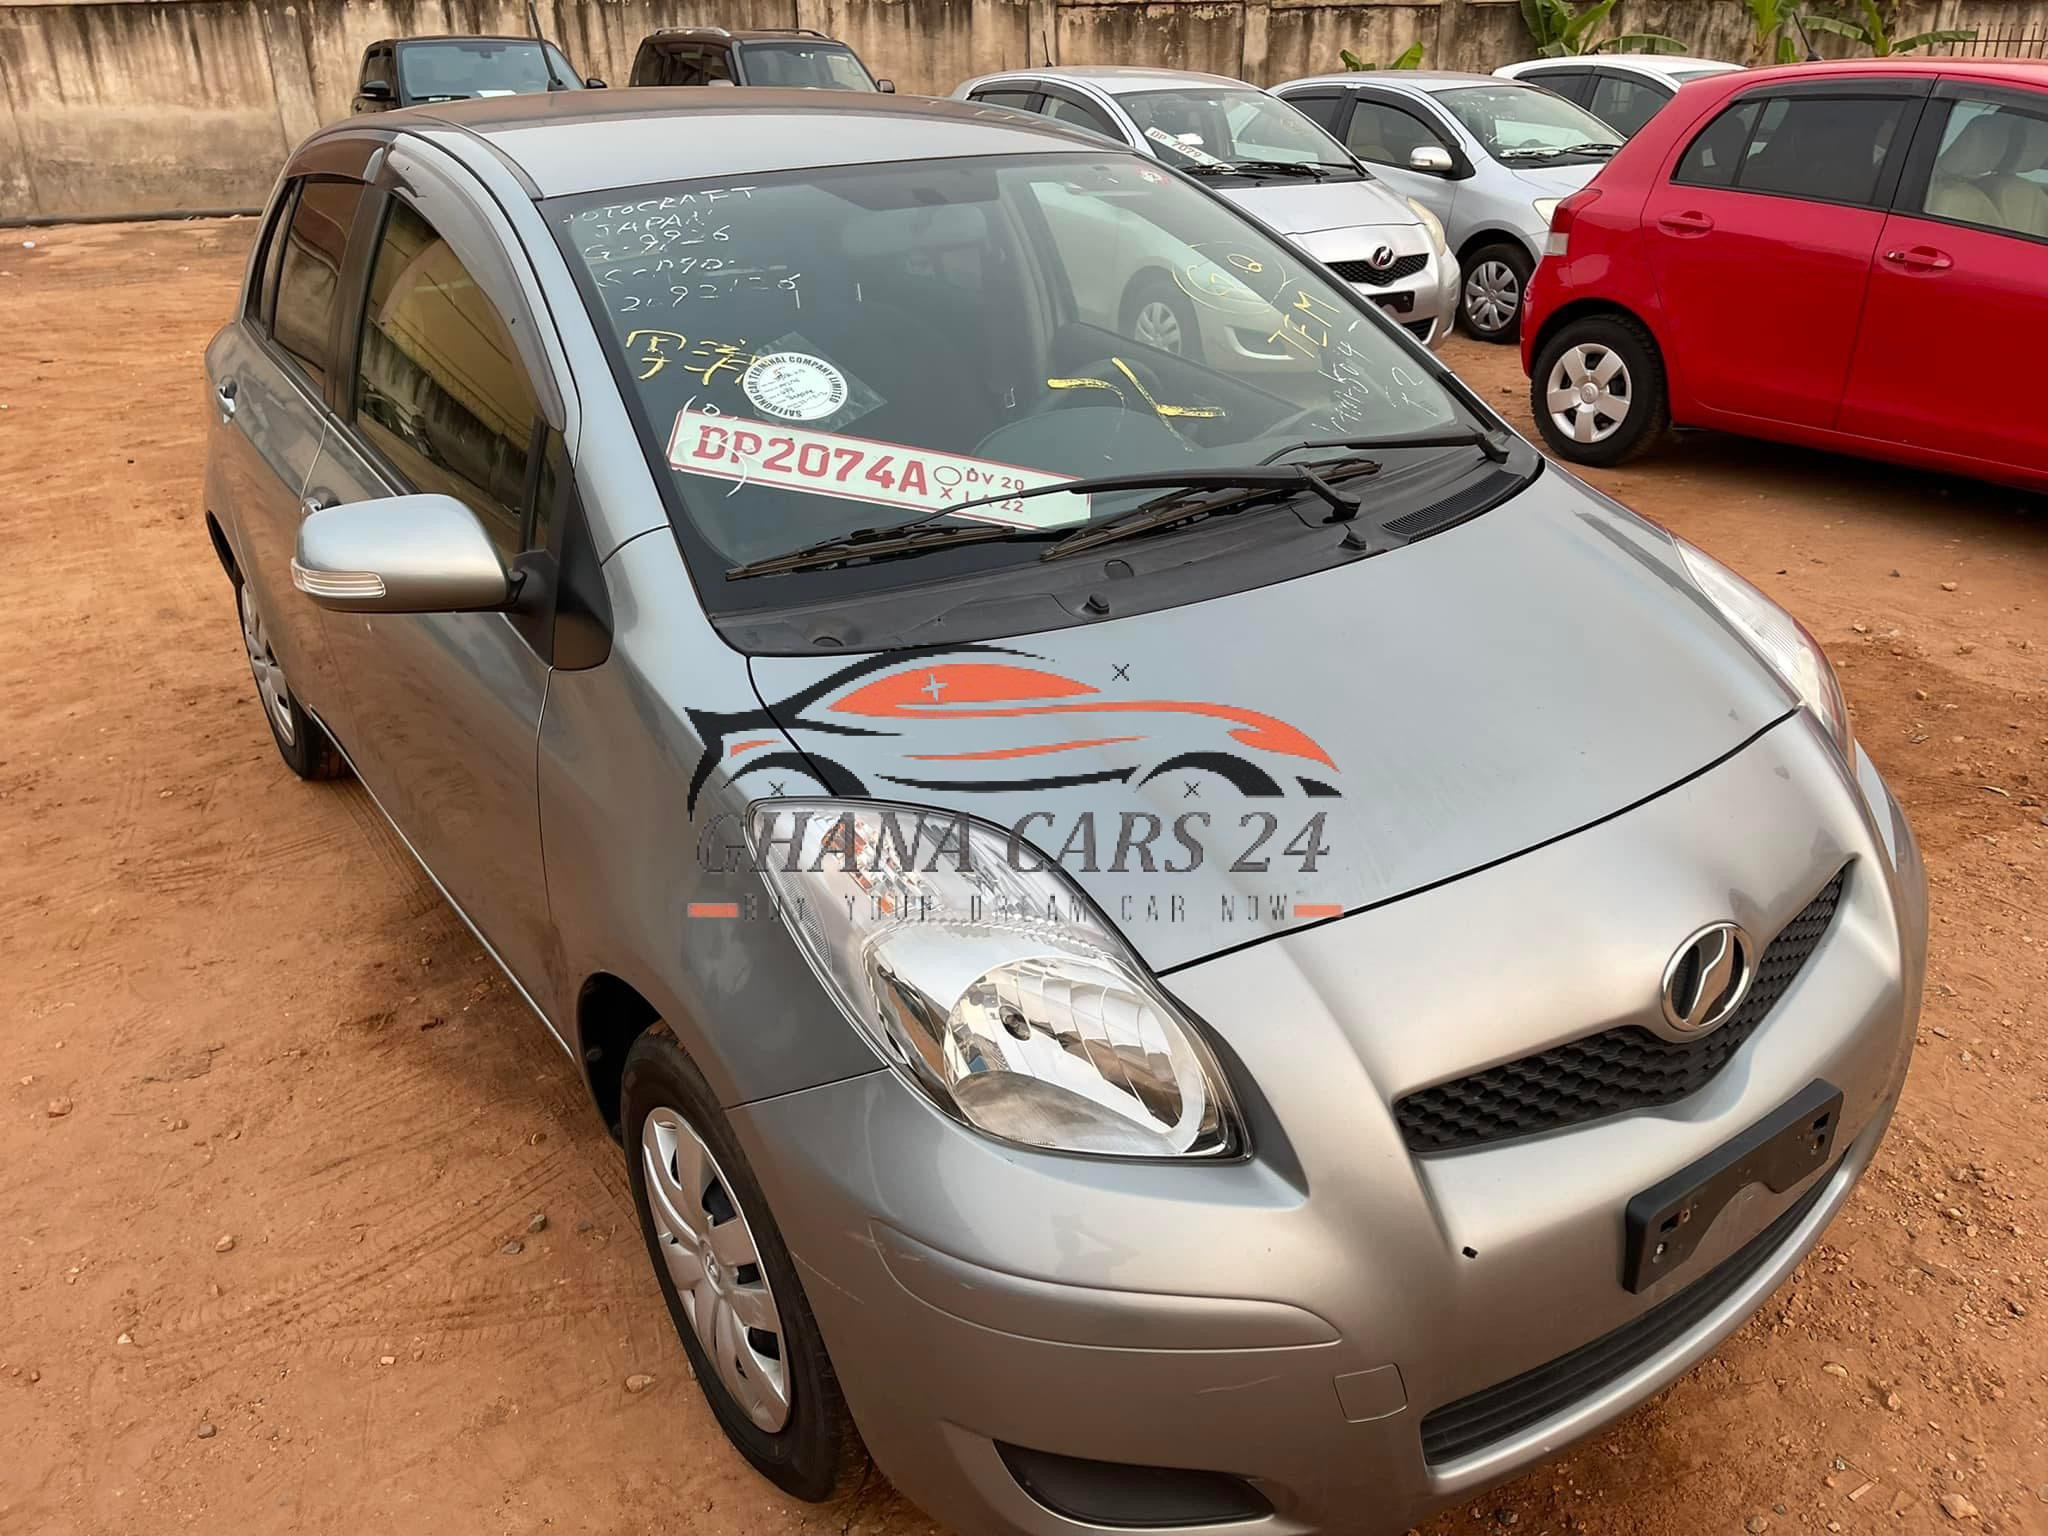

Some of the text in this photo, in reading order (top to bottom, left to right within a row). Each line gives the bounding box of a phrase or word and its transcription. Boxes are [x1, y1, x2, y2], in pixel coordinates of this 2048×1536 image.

[788, 356, 833, 376] COMPANY
[829, 376, 842, 403] LIMITED
[692, 424, 928, 496] DP2074A
